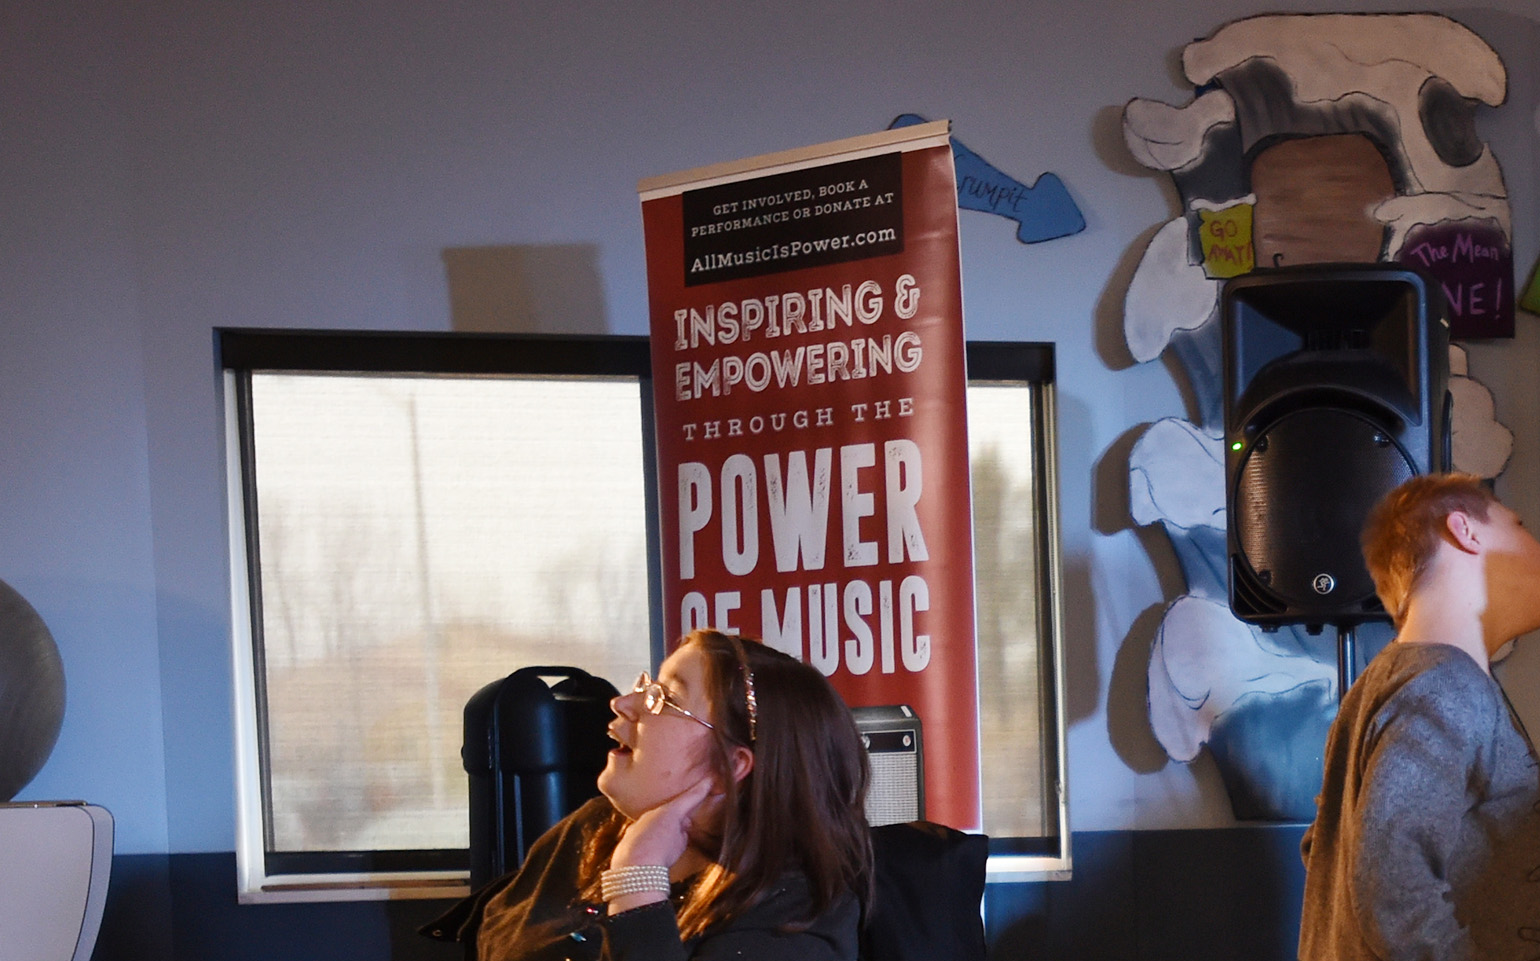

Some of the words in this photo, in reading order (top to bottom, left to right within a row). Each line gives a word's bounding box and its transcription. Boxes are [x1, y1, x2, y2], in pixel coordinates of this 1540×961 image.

[691, 211, 790, 238] PERFORMANCE
[793, 208, 811, 219] OR
[815, 196, 871, 217] DONATE
[875, 192, 895, 206] AT
[713, 202, 739, 216] GET
[742, 188, 816, 211] INVOLVED,
[819, 180, 856, 197] BOOK
[858, 179, 869, 190] A
[691, 227, 897, 273] AllMusicIsPower.com
[1210, 219, 1238, 241] GO
[1410, 242, 1449, 267] The
[1452, 233, 1500, 264] Mean
[674, 280, 884, 351] INSPIRING
[894, 273, 921, 320] &
[675, 331, 923, 401] EMPOWERING
[683, 407, 834, 441] THROUGH
[851, 397, 915, 422] THE
[678, 438, 930, 580] POWER
[760, 575, 932, 678] MUSIC
